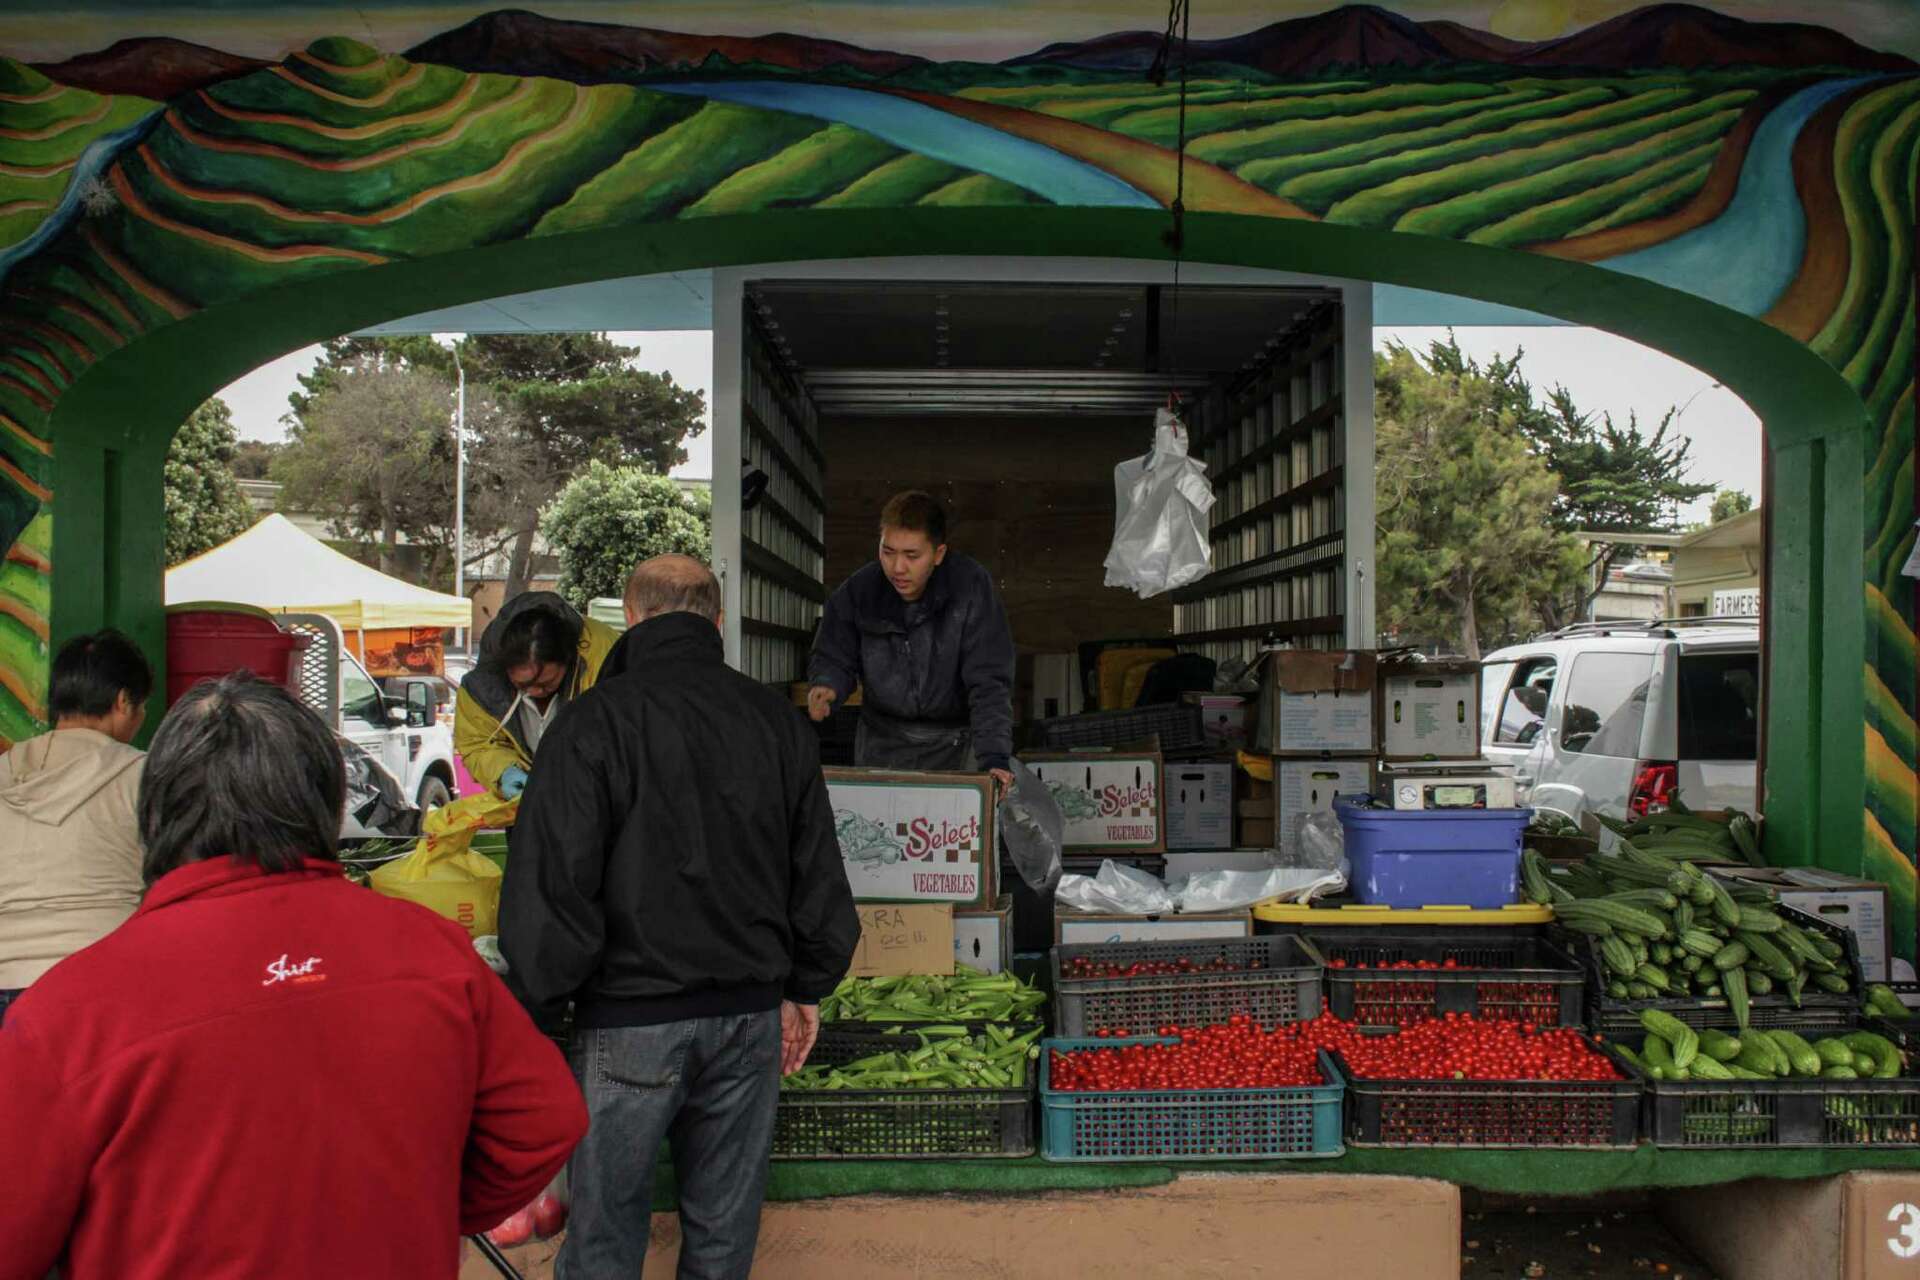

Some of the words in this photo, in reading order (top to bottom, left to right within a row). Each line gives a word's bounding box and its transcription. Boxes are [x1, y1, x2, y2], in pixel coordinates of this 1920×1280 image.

[1715, 594, 1760, 616] FARMERS
[1101, 782, 1152, 815] Select
[906, 814, 976, 858] Select
[1106, 825, 1153, 840] VEGETABLES
[913, 873, 974, 893] VEGETABLES
[1887, 1202, 1920, 1258] 3
